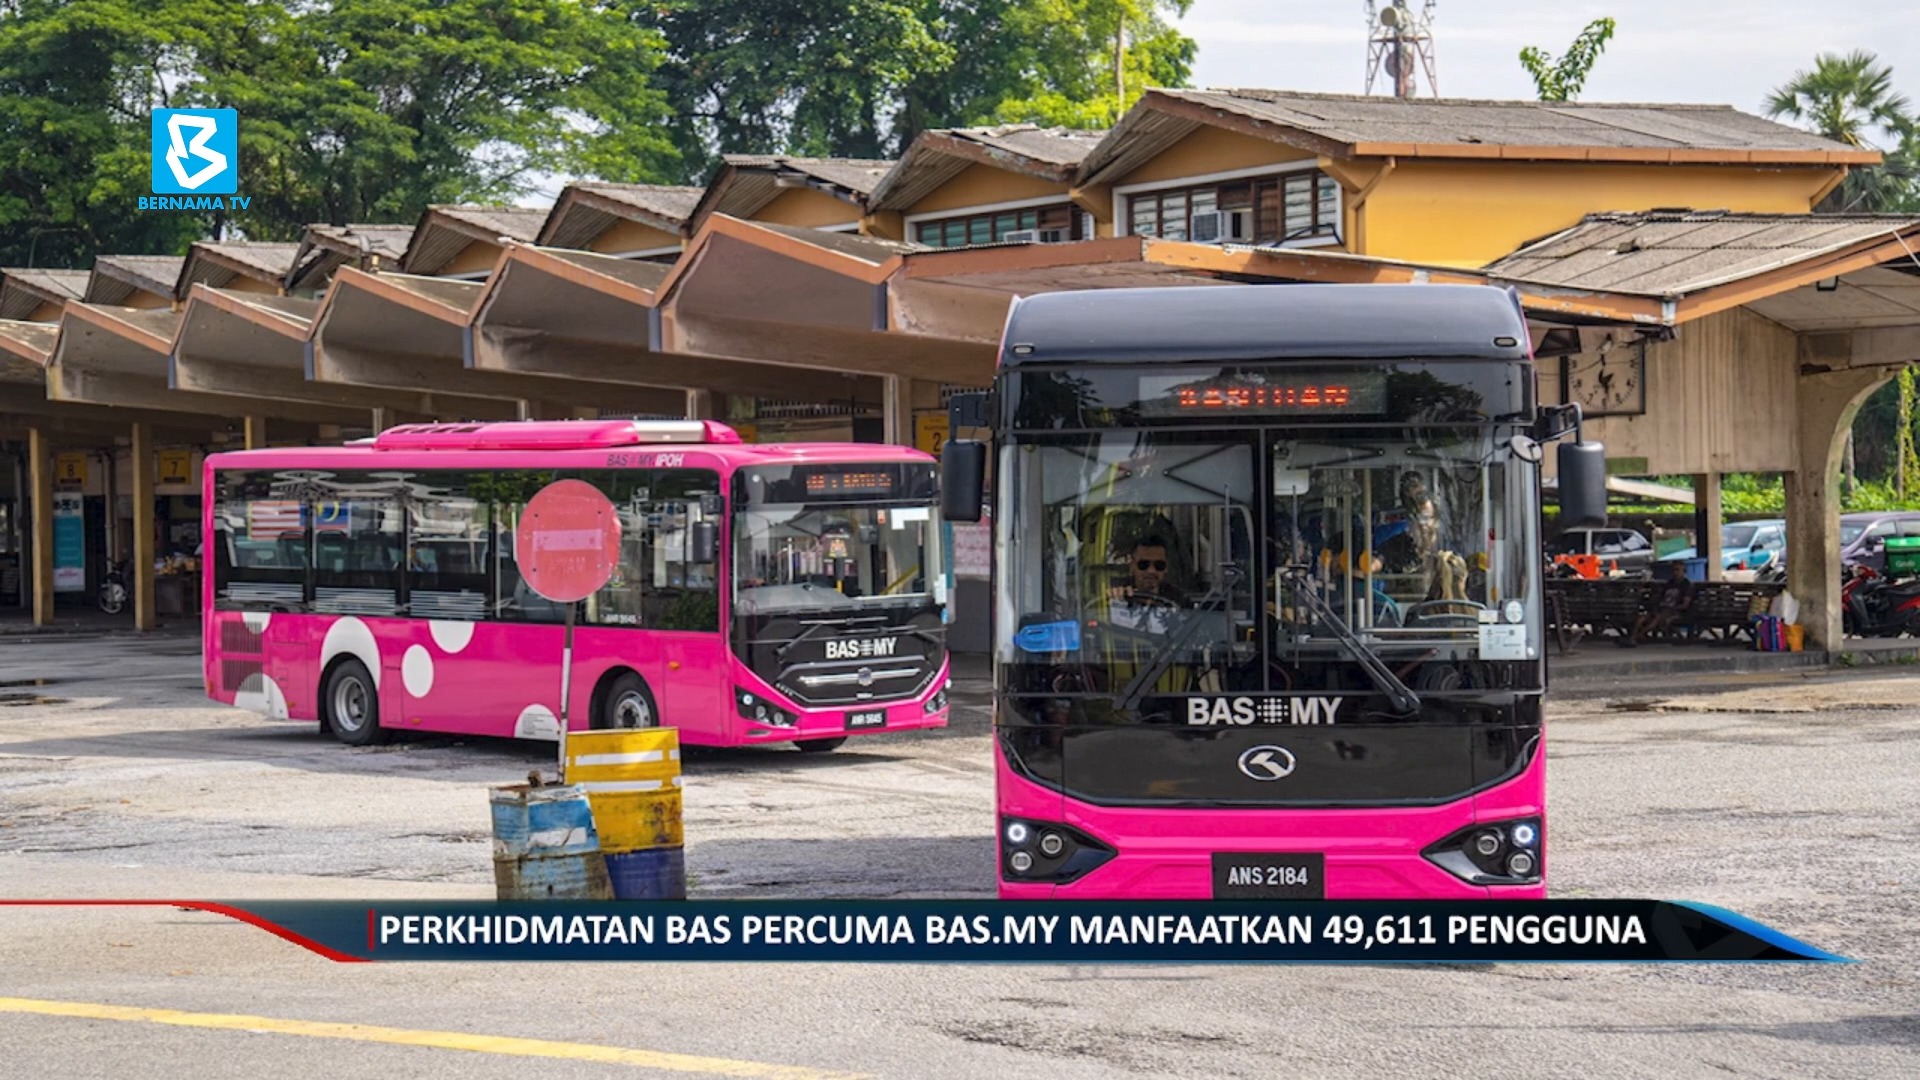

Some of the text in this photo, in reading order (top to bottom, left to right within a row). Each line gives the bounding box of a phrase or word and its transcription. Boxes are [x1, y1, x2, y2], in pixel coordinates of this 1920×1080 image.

[932, 431, 941, 452] 2
[171, 461, 179, 475] 7
[607, 454, 628, 467] BAS
[655, 454, 684, 467] IPOH
[67, 464, 75, 477] 8
[825, 637, 897, 659] BAS MY
[1187, 697, 1343, 725] BAS MY
[1228, 866, 1309, 885] ANS 2184
